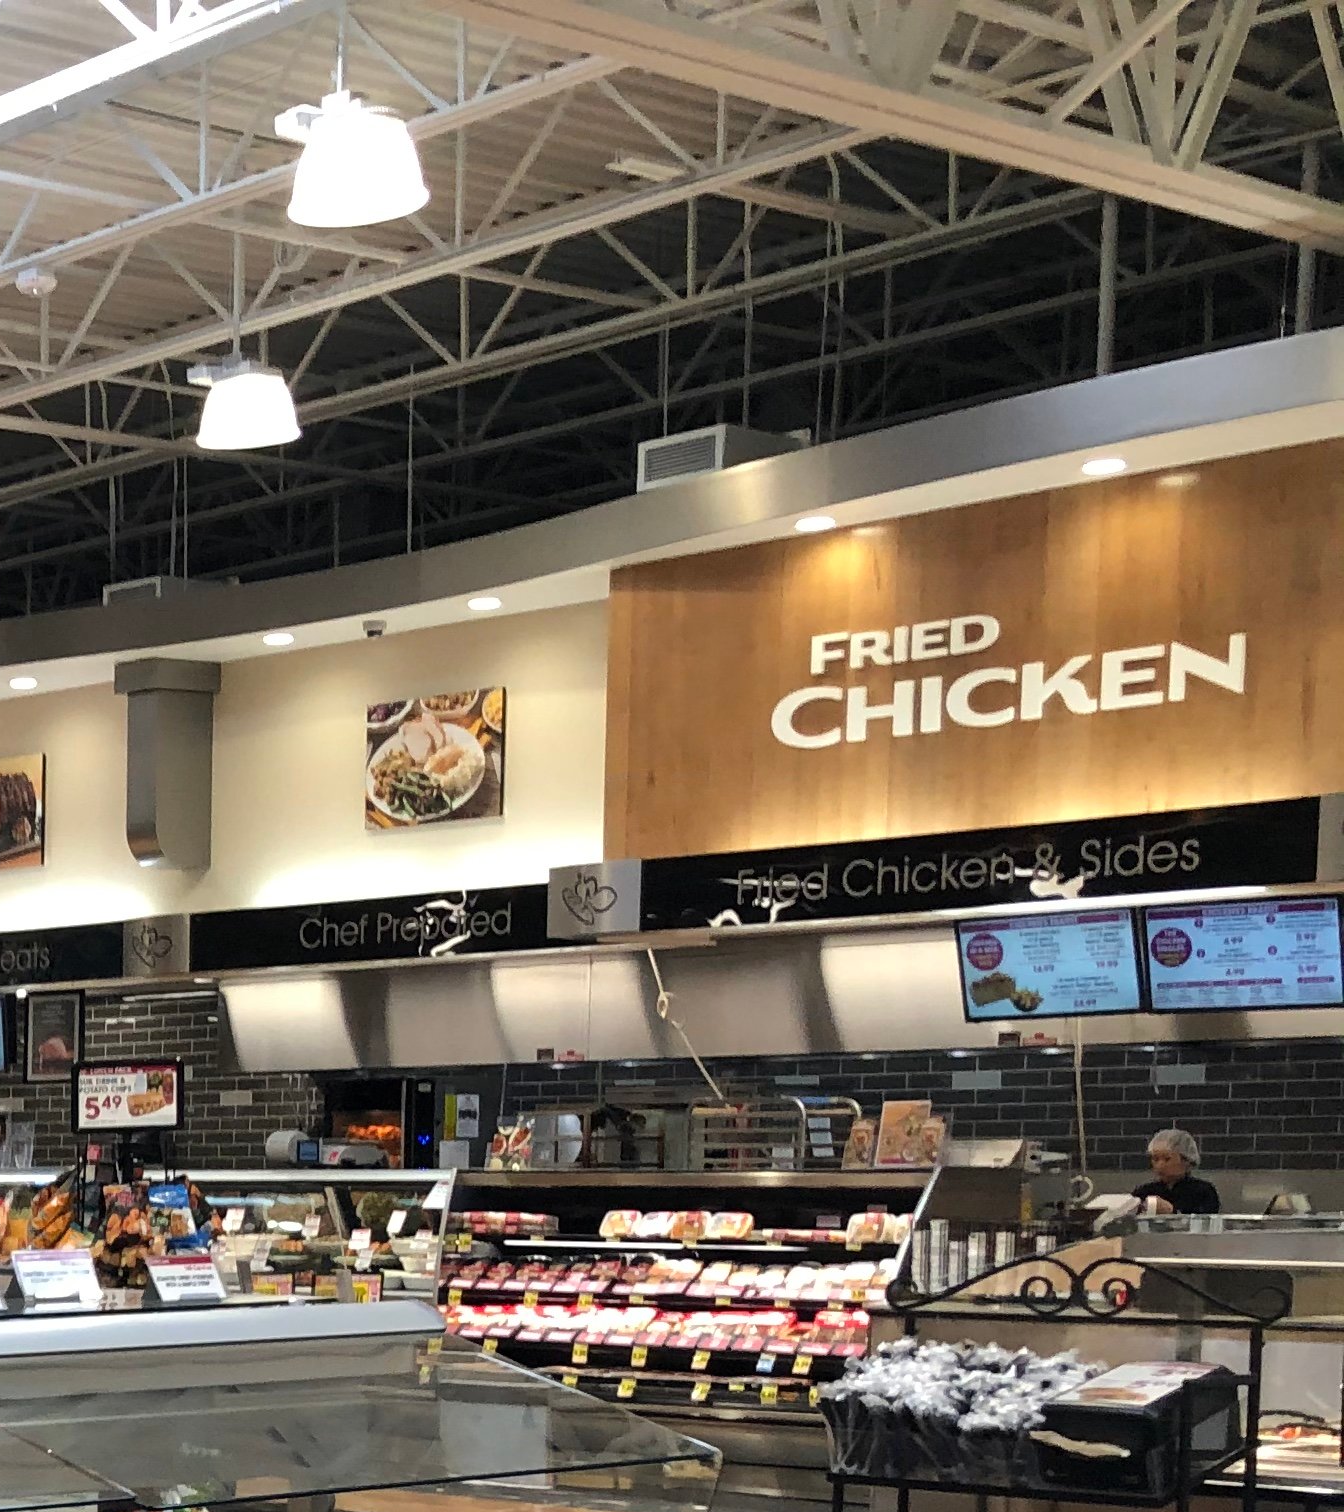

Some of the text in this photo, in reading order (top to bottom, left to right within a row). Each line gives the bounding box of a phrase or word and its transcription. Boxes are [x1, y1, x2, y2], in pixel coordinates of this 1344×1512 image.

[810, 614, 1000, 675] FRIED
[770, 632, 1247, 749] CHICKEN
[736, 862, 829, 907] Fried
[843, 853, 1015, 898] Chicken
[1080, 836, 1201, 879] Sides
[299, 902, 512, 956] Chef Prepared
